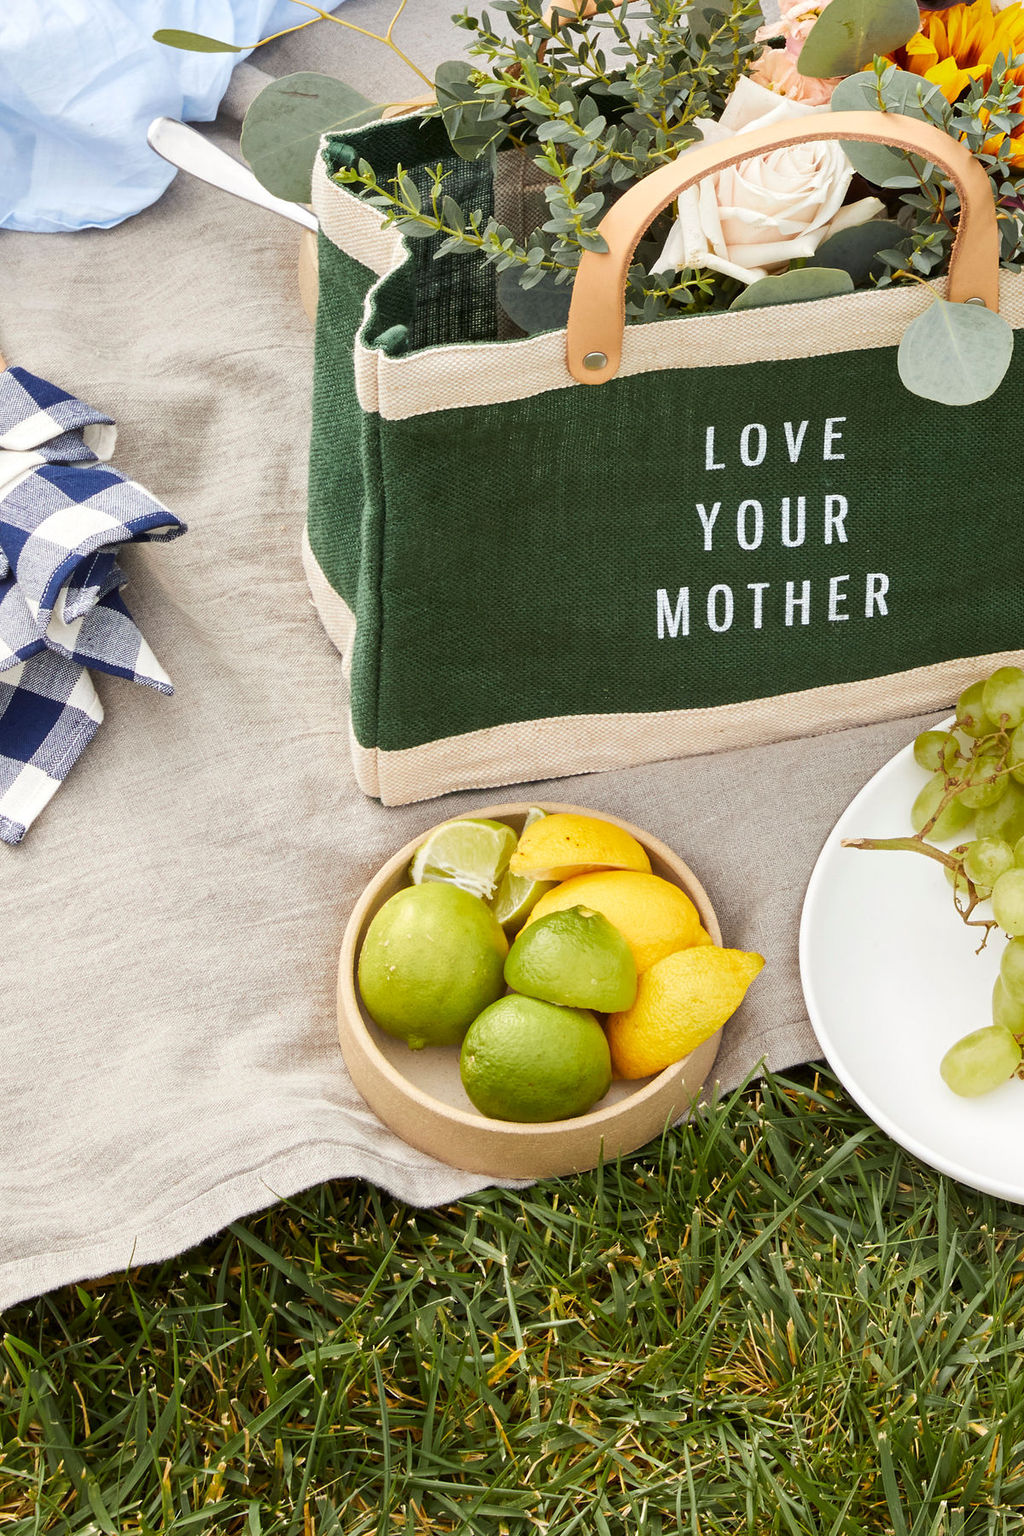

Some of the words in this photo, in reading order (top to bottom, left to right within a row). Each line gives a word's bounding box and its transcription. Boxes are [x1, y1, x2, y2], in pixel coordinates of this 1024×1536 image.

[704, 416, 848, 471] LOVE
[695, 494, 849, 551] YOUR
[656, 572, 890, 640] MOTHER
